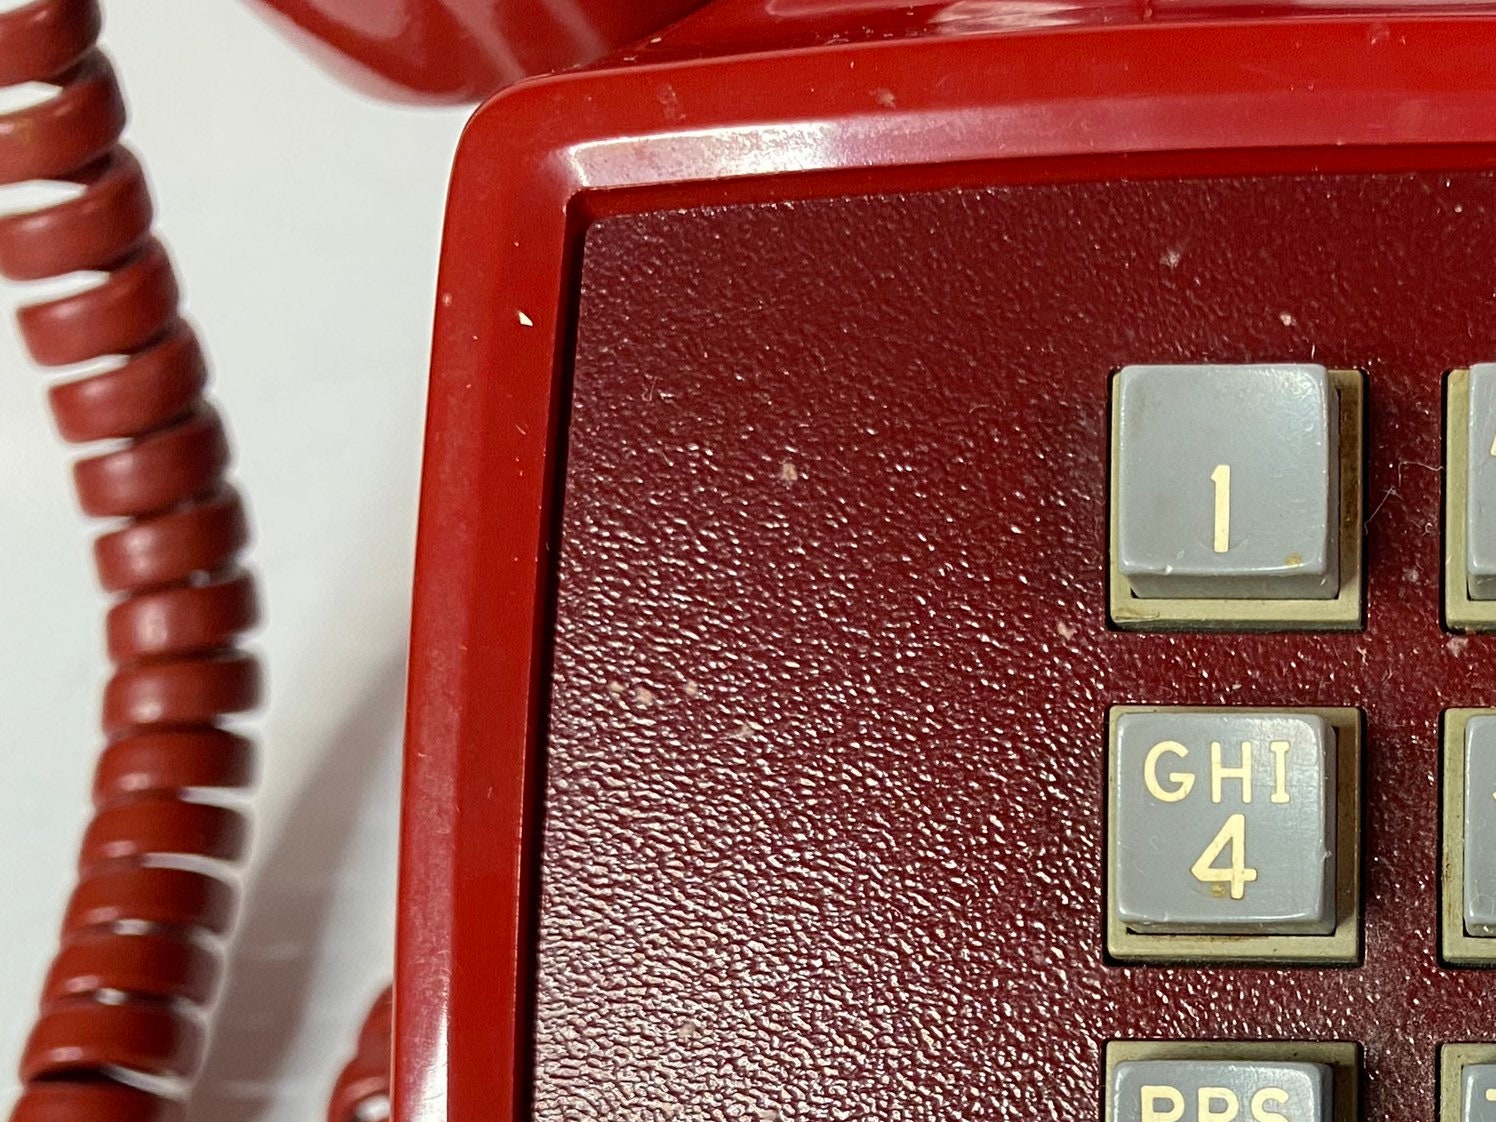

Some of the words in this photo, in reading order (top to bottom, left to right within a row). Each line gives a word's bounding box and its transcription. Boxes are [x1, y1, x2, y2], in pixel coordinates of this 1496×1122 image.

[1208, 462, 1230, 553] 1
[1144, 738, 1290, 806] GHI
[1191, 813, 1257, 899] 4
